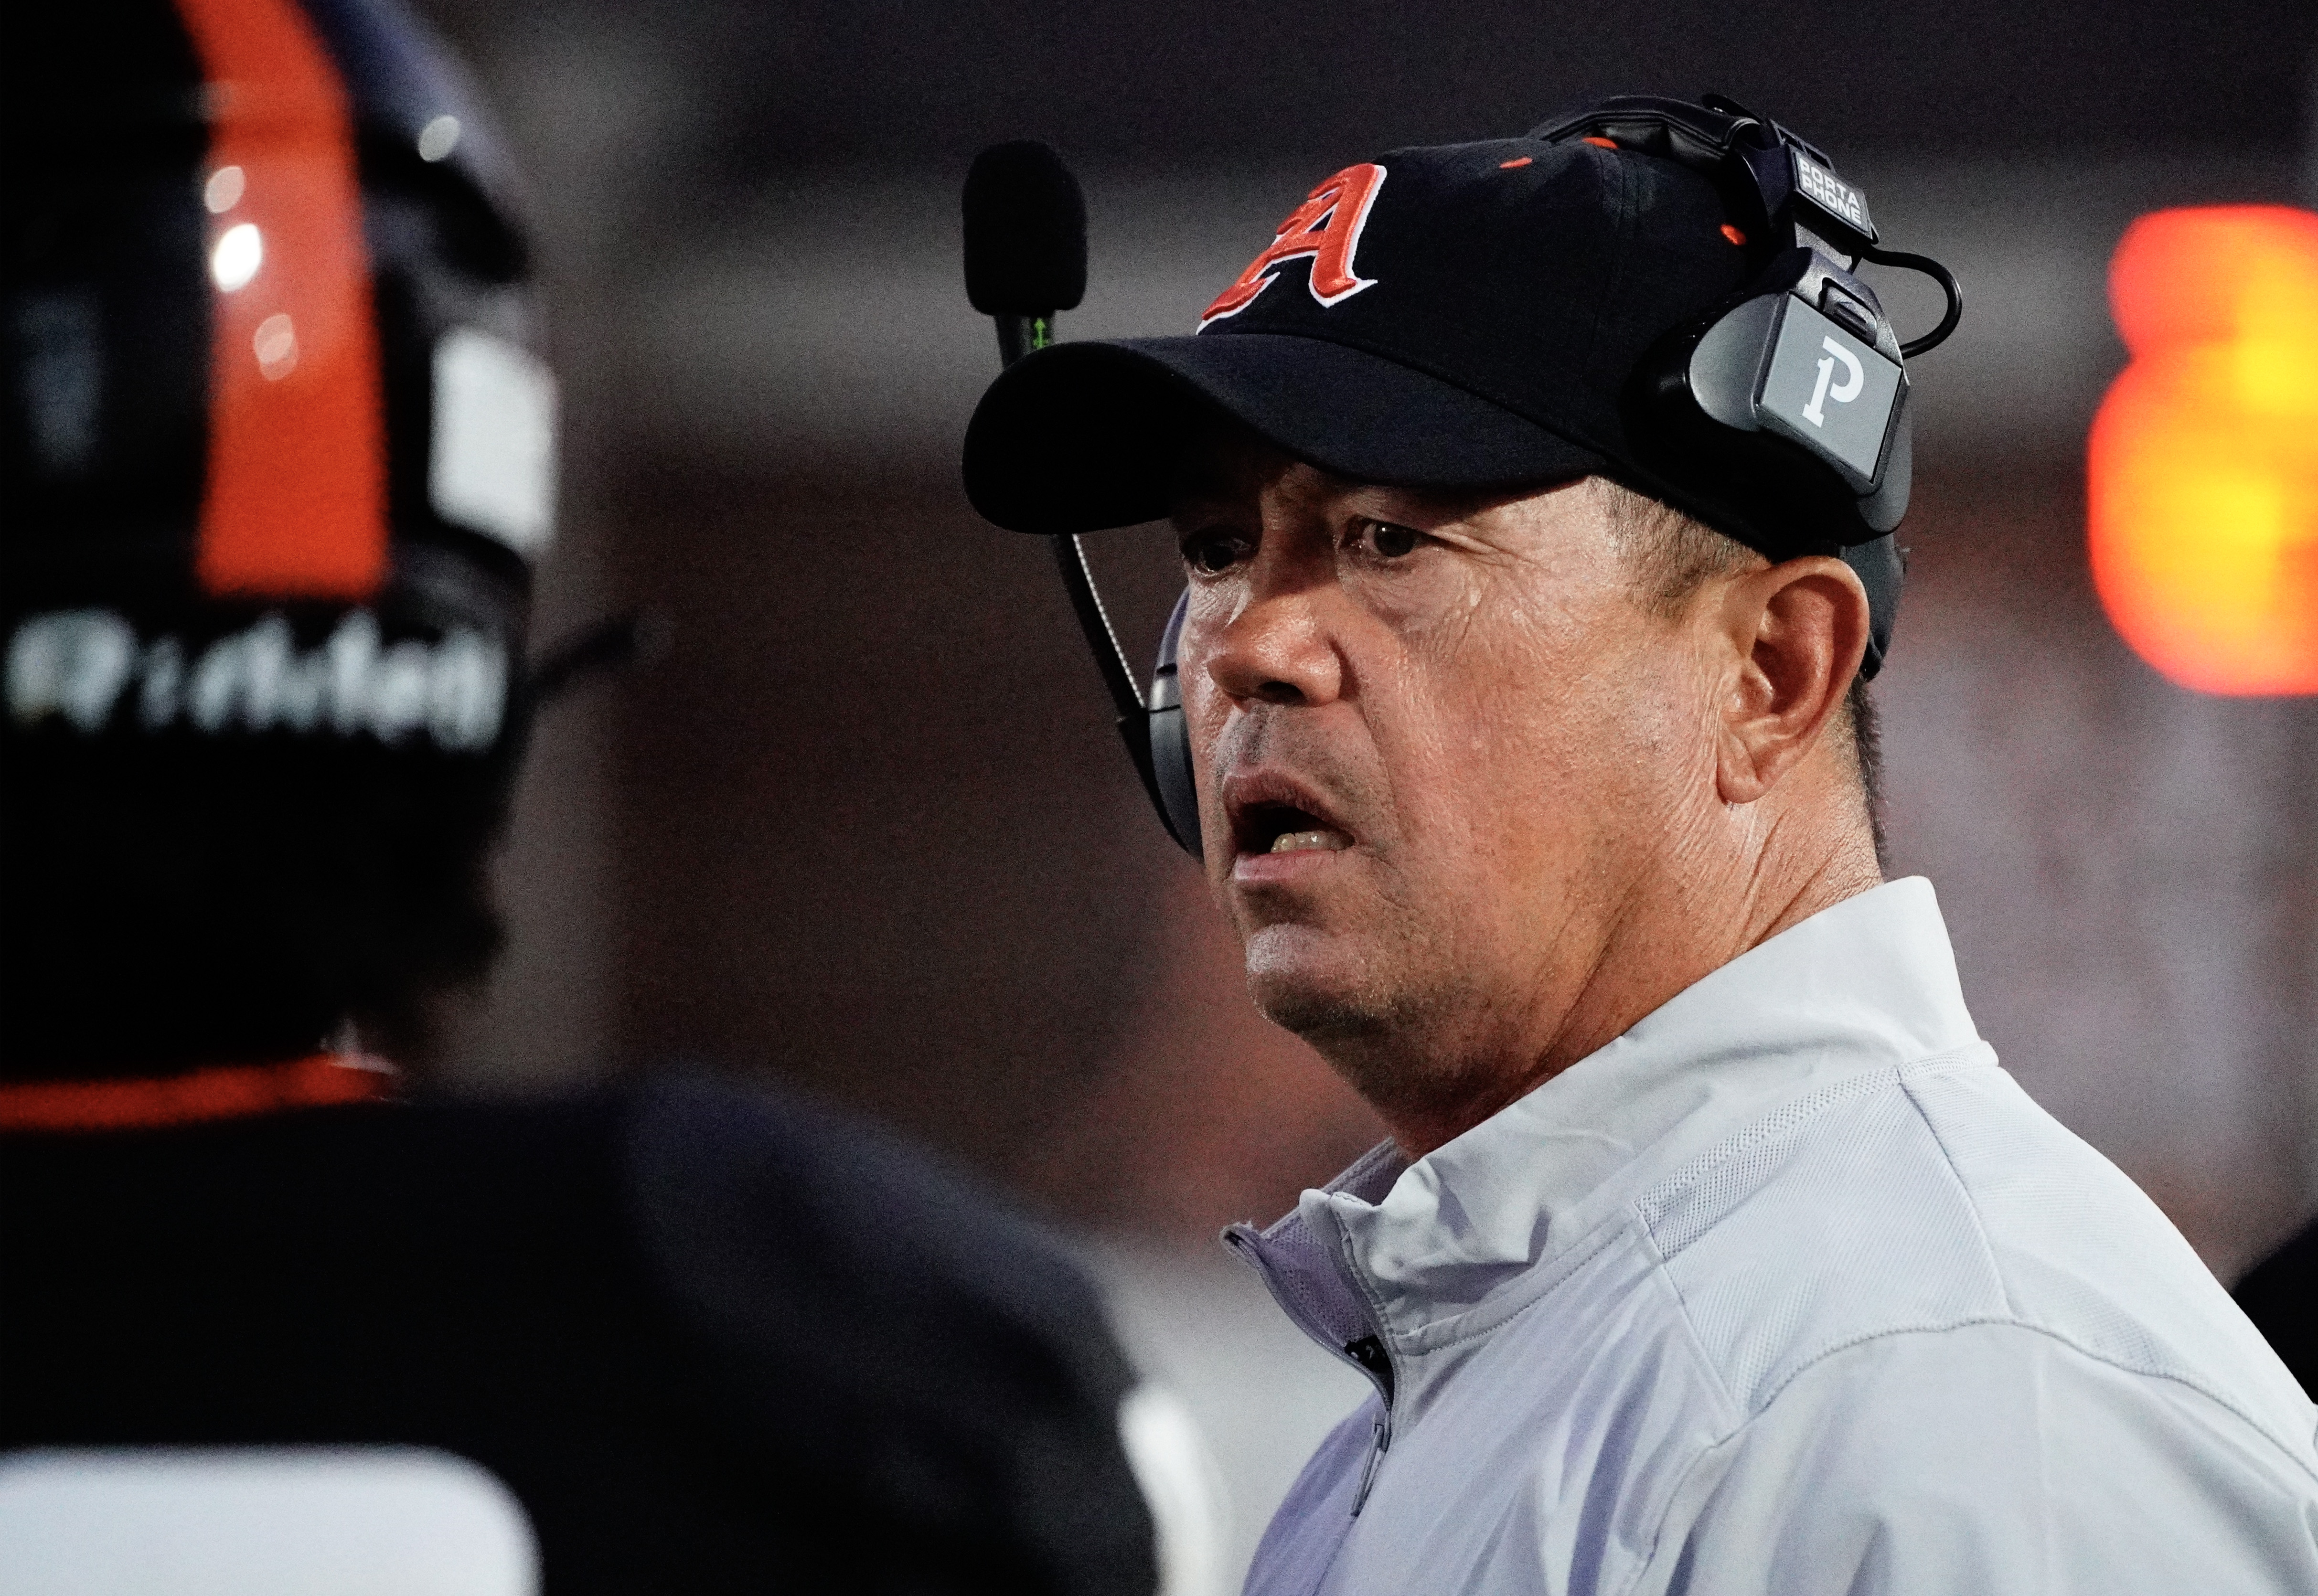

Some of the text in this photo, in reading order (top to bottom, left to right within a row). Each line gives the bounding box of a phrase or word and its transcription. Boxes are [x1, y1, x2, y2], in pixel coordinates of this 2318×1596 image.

[1799, 158, 1860, 209] PORTA
[1802, 175, 1862, 225] PHONE
[1196, 163, 1387, 335] A
